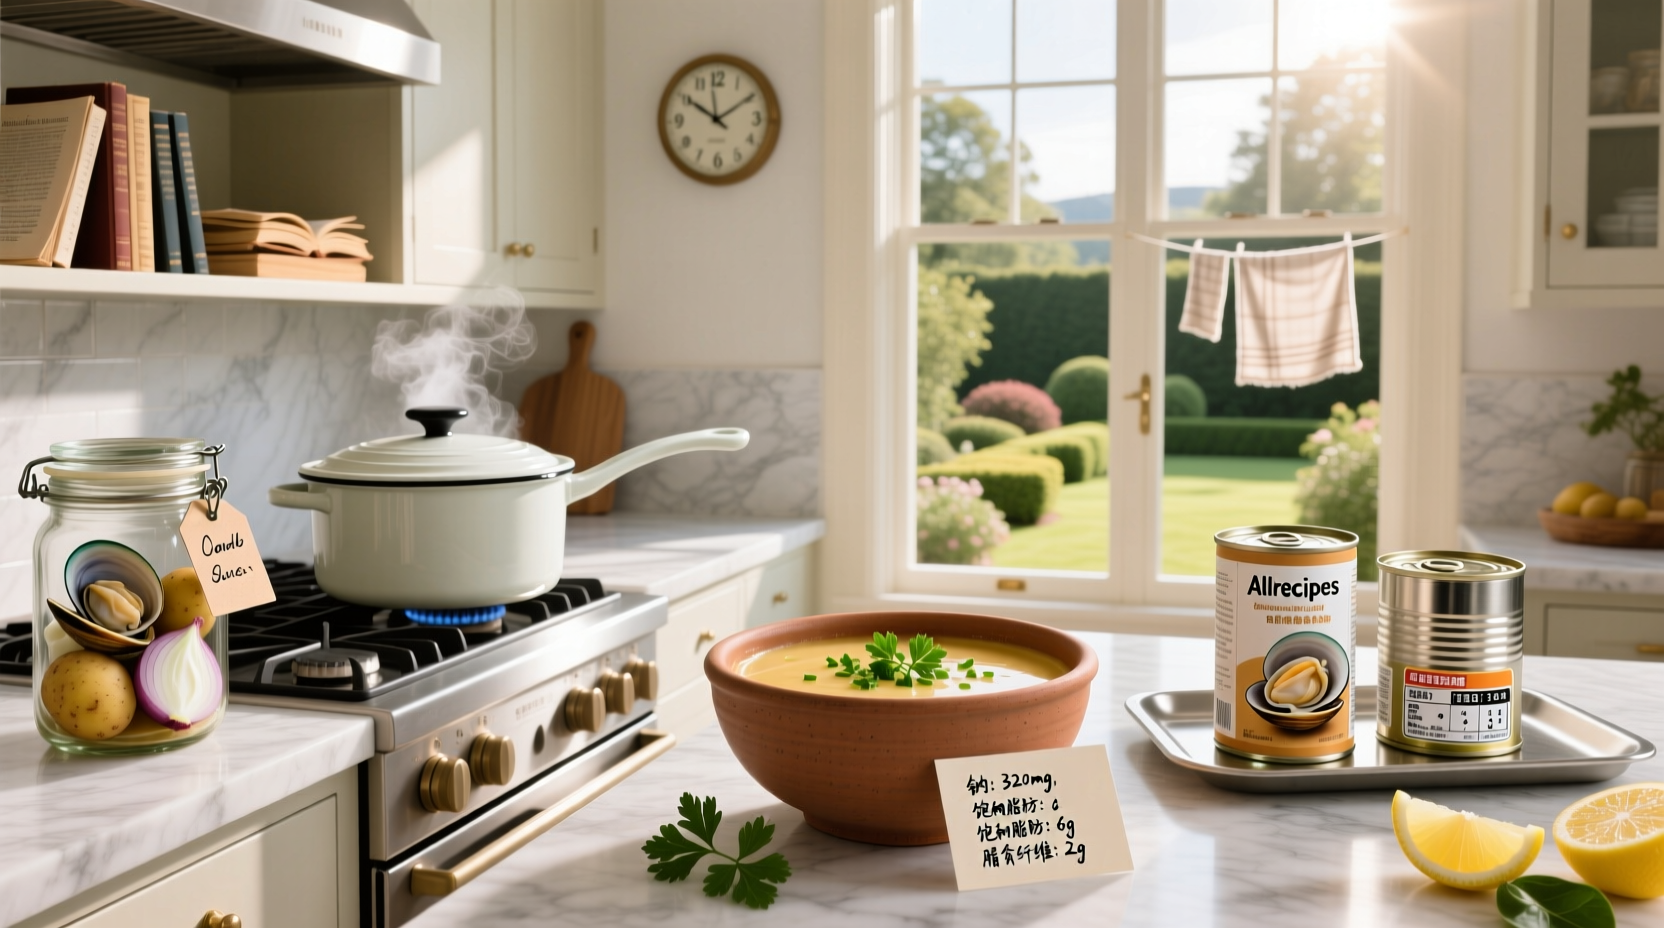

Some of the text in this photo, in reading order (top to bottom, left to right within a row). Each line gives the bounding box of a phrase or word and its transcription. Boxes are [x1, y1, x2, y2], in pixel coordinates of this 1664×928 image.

[695, 77, 705, 91] 11
[711, 71, 725, 87] 12
[675, 113, 684, 128] 9
[751, 111, 762, 127] 3
[713, 152, 723, 169] 6
[1247, 574, 1339, 602] Allrecipes
[1056, 815, 1075, 840] 6g
[1064, 840, 1086, 865] 2g
